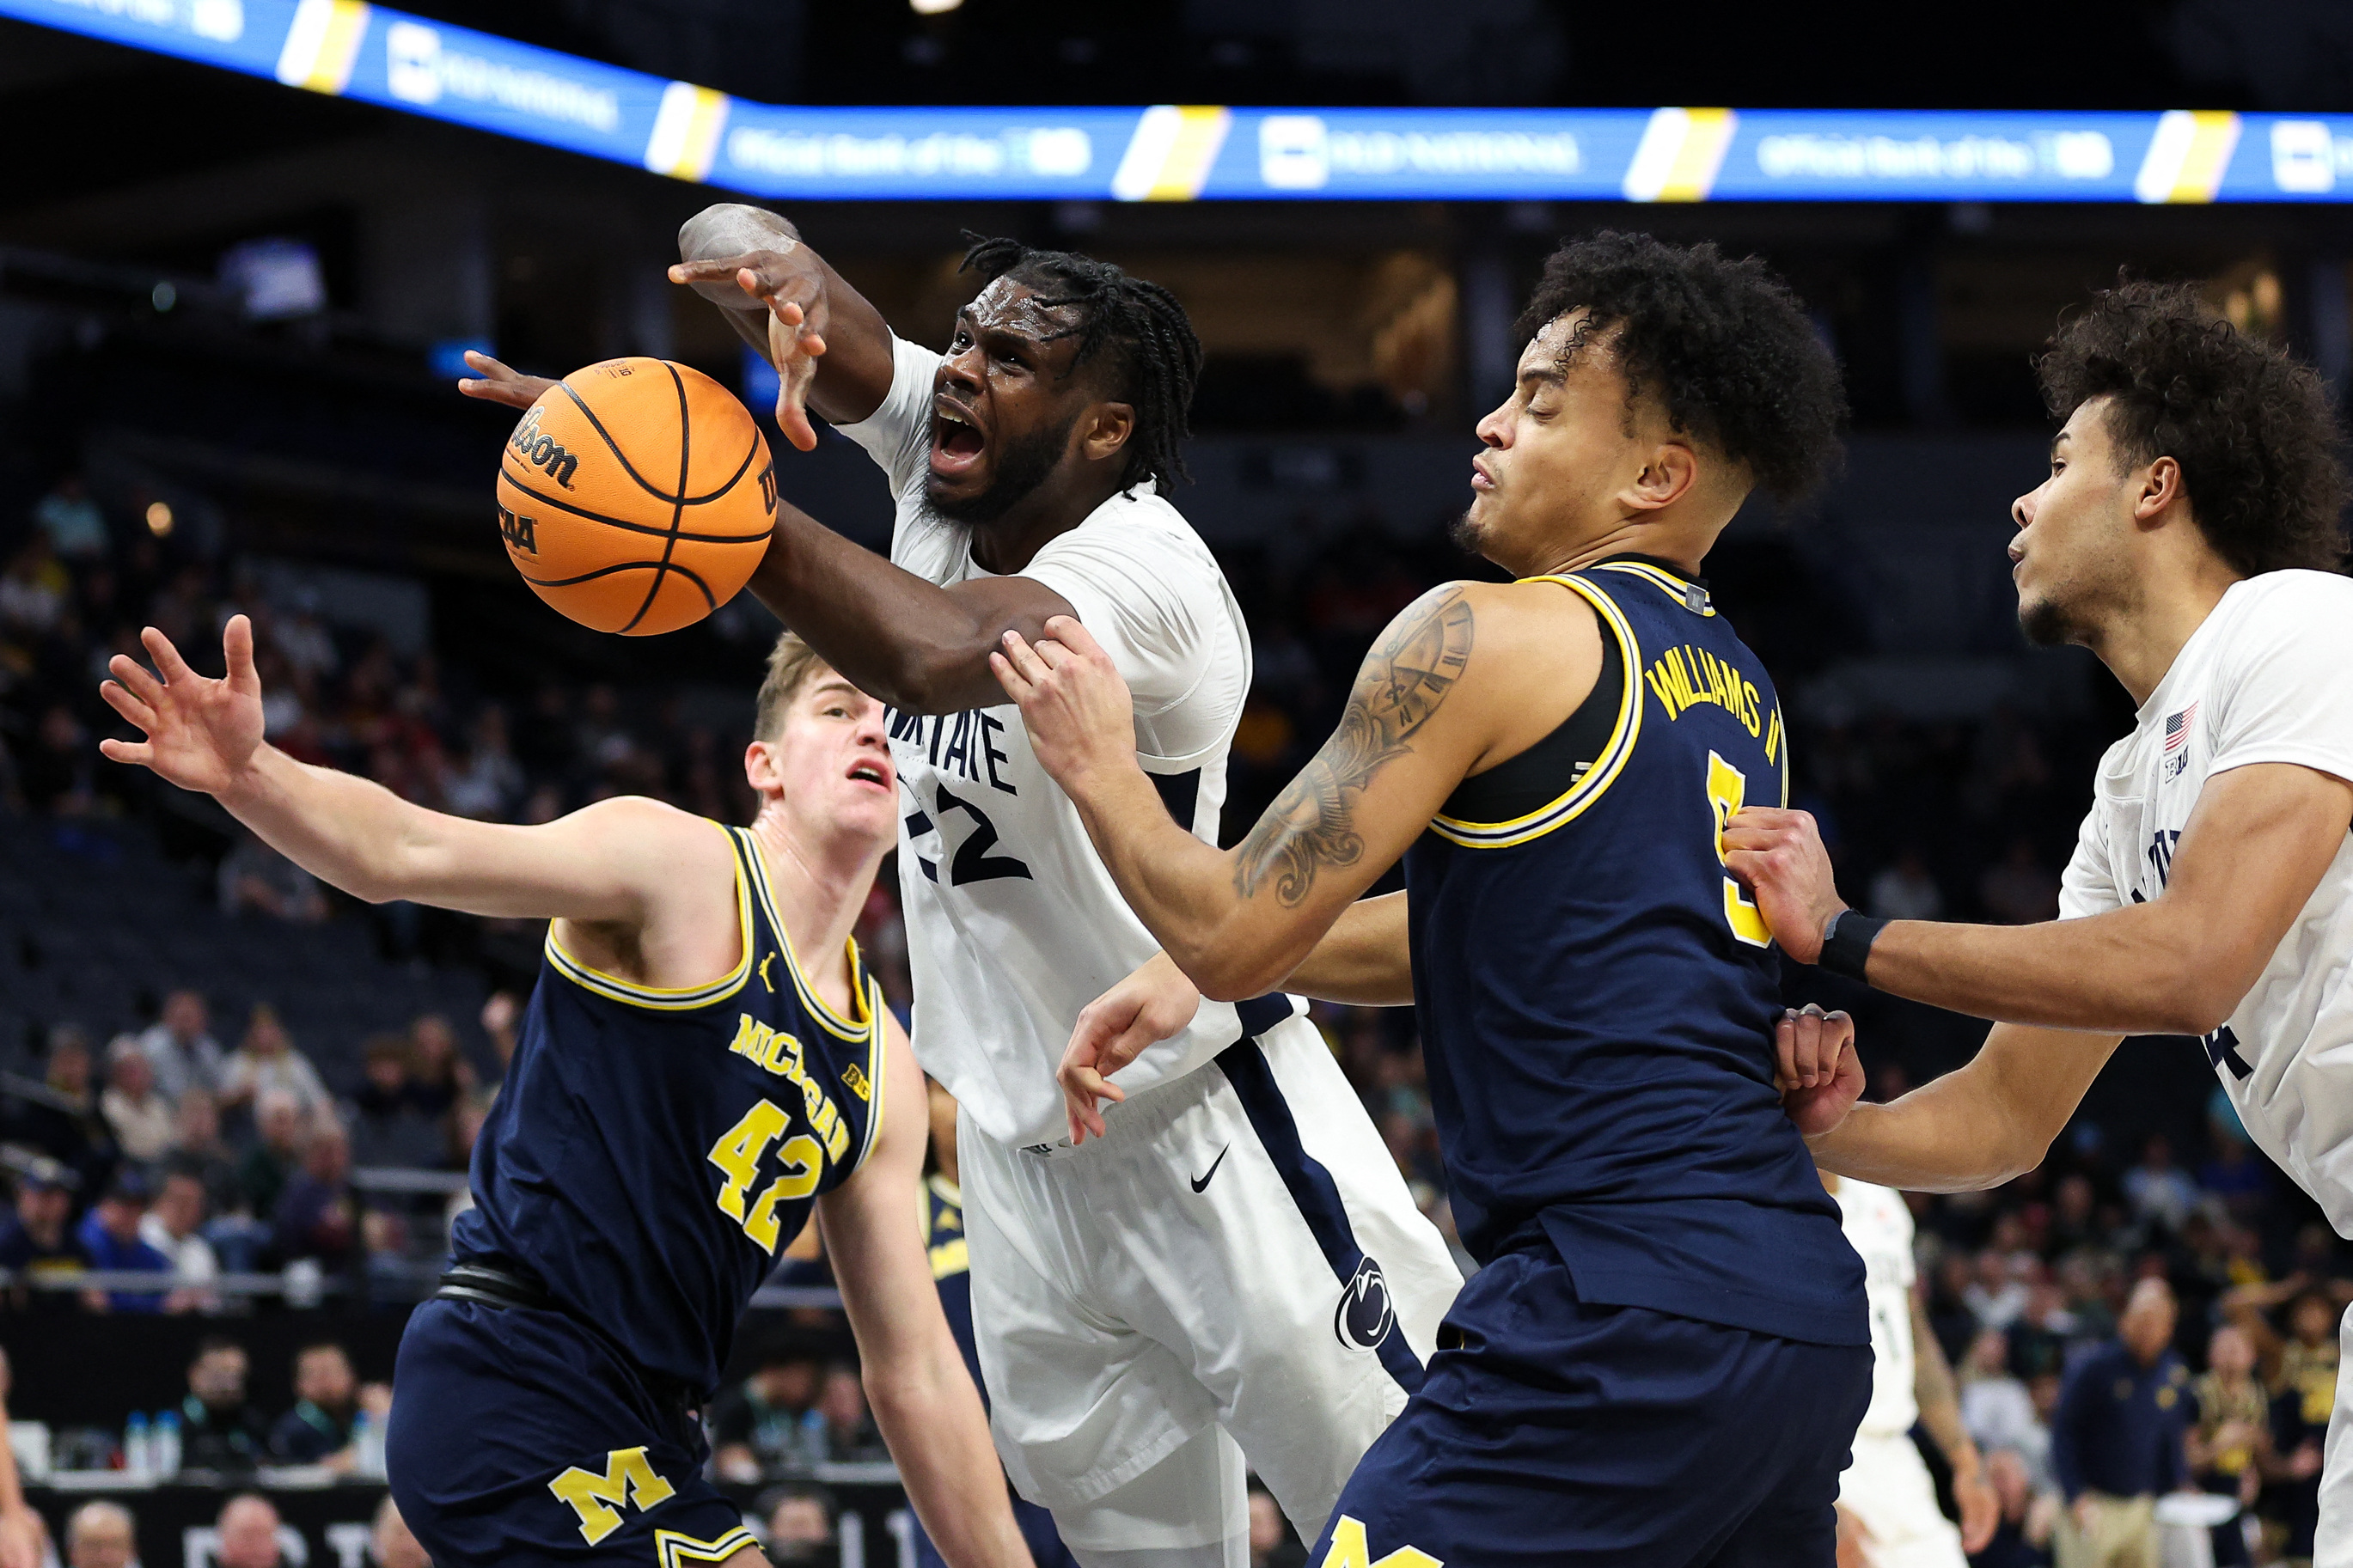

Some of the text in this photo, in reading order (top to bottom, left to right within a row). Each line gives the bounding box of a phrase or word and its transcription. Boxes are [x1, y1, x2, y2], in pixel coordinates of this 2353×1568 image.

[1644, 644, 1760, 738] WILLIAMS
[706, 1097, 824, 1256] 42
[547, 1445, 676, 1547] M
